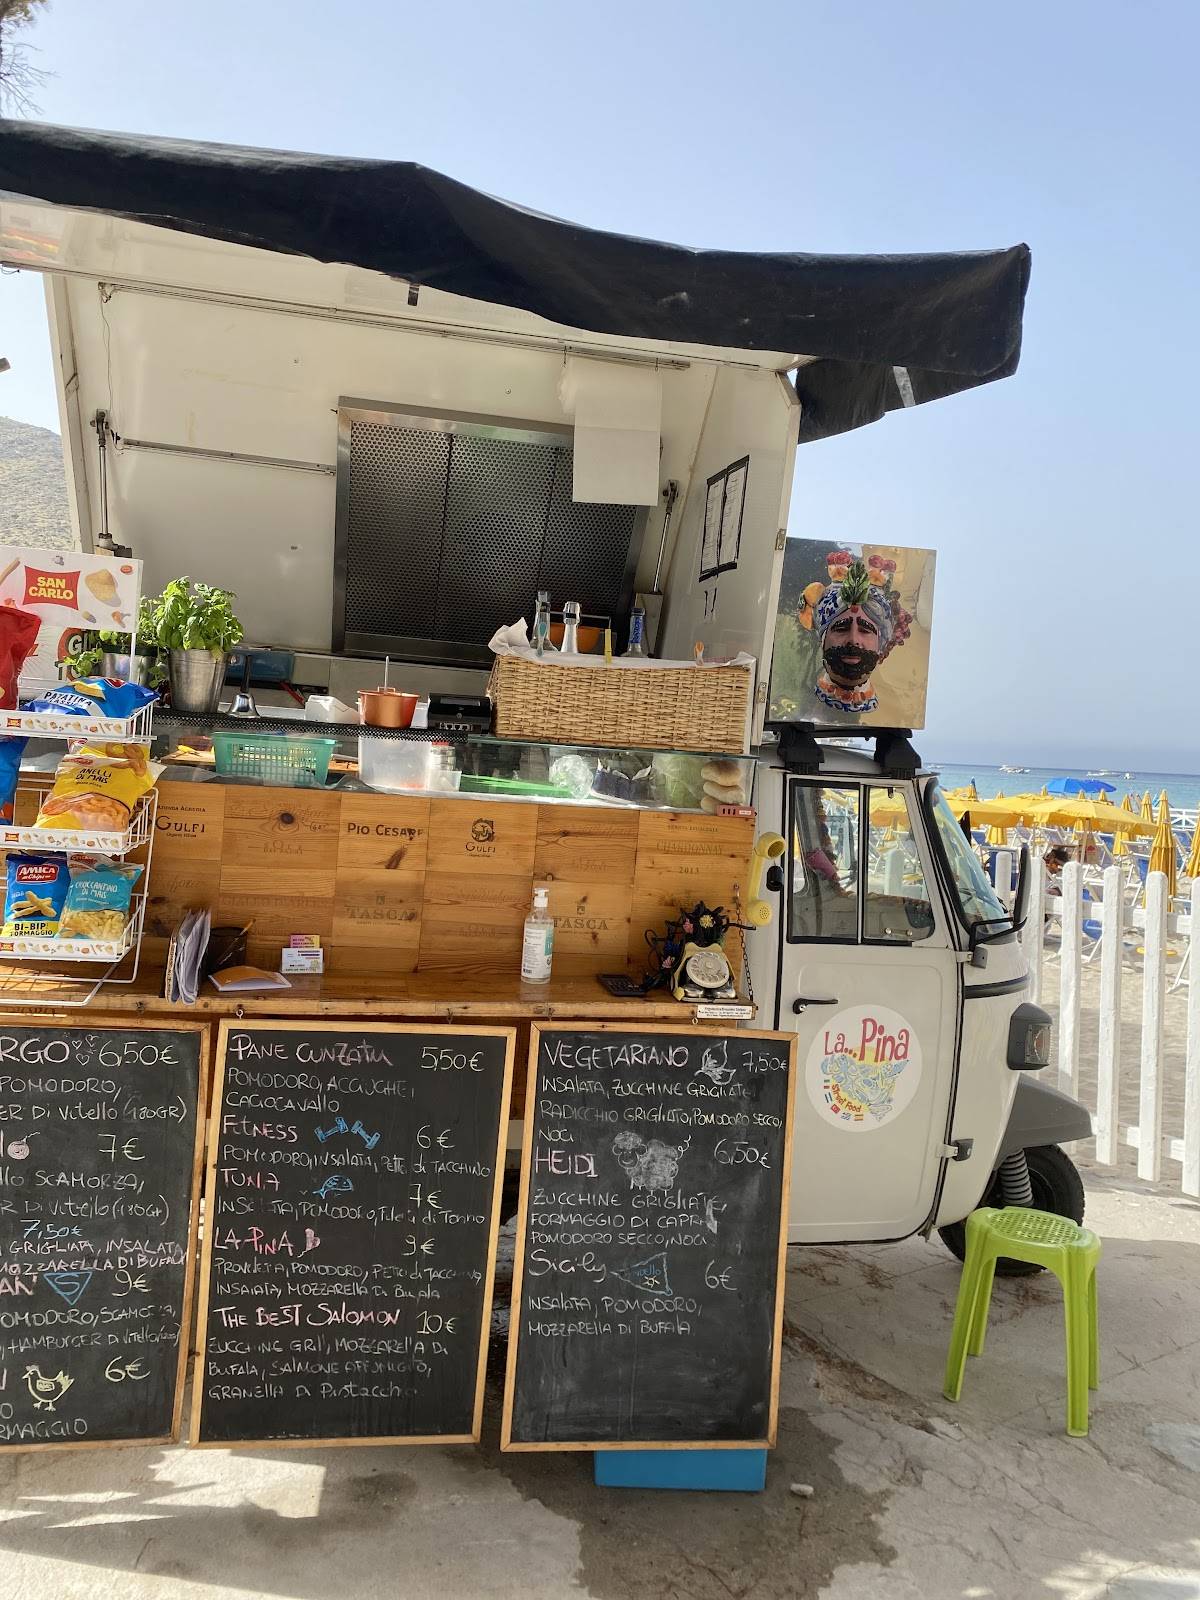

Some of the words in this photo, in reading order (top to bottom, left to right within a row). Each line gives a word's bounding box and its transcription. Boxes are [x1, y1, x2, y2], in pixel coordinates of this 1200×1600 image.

[28, 586, 74, 600] CARLO
[37, 576, 66, 589] SAN
[347, 822, 370, 836] PIO
[19, 867, 56, 876] AMICA
[14, 923, 46, 931] BI-BIP
[229, 1033, 289, 1060] PANE
[858, 1017, 910, 1062] Pina
[544, 1040, 689, 1070] VEGETARIANO
[742, 1051, 787, 1073] 7,50€
[98, 1134, 145, 1162] 7€
[535, 1146, 598, 1177] HEIDI
[533, 1188, 622, 1207] ZUCCHINE
[20, 1219, 83, 1240] 7,50€
[530, 1213, 625, 1228] FORMAGGIO
[214, 1226, 241, 1250] LA
[530, 1231, 612, 1245] POMODORO
[118, 1256, 133, 1269] DI
[112, 1269, 152, 1296] 9€
[705, 1259, 738, 1290] 6€
[213, 1306, 249, 1328] THE
[255, 1304, 303, 1326] BEST
[416, 1310, 460, 1334] 10€
[105, 1355, 150, 1382] 6€
